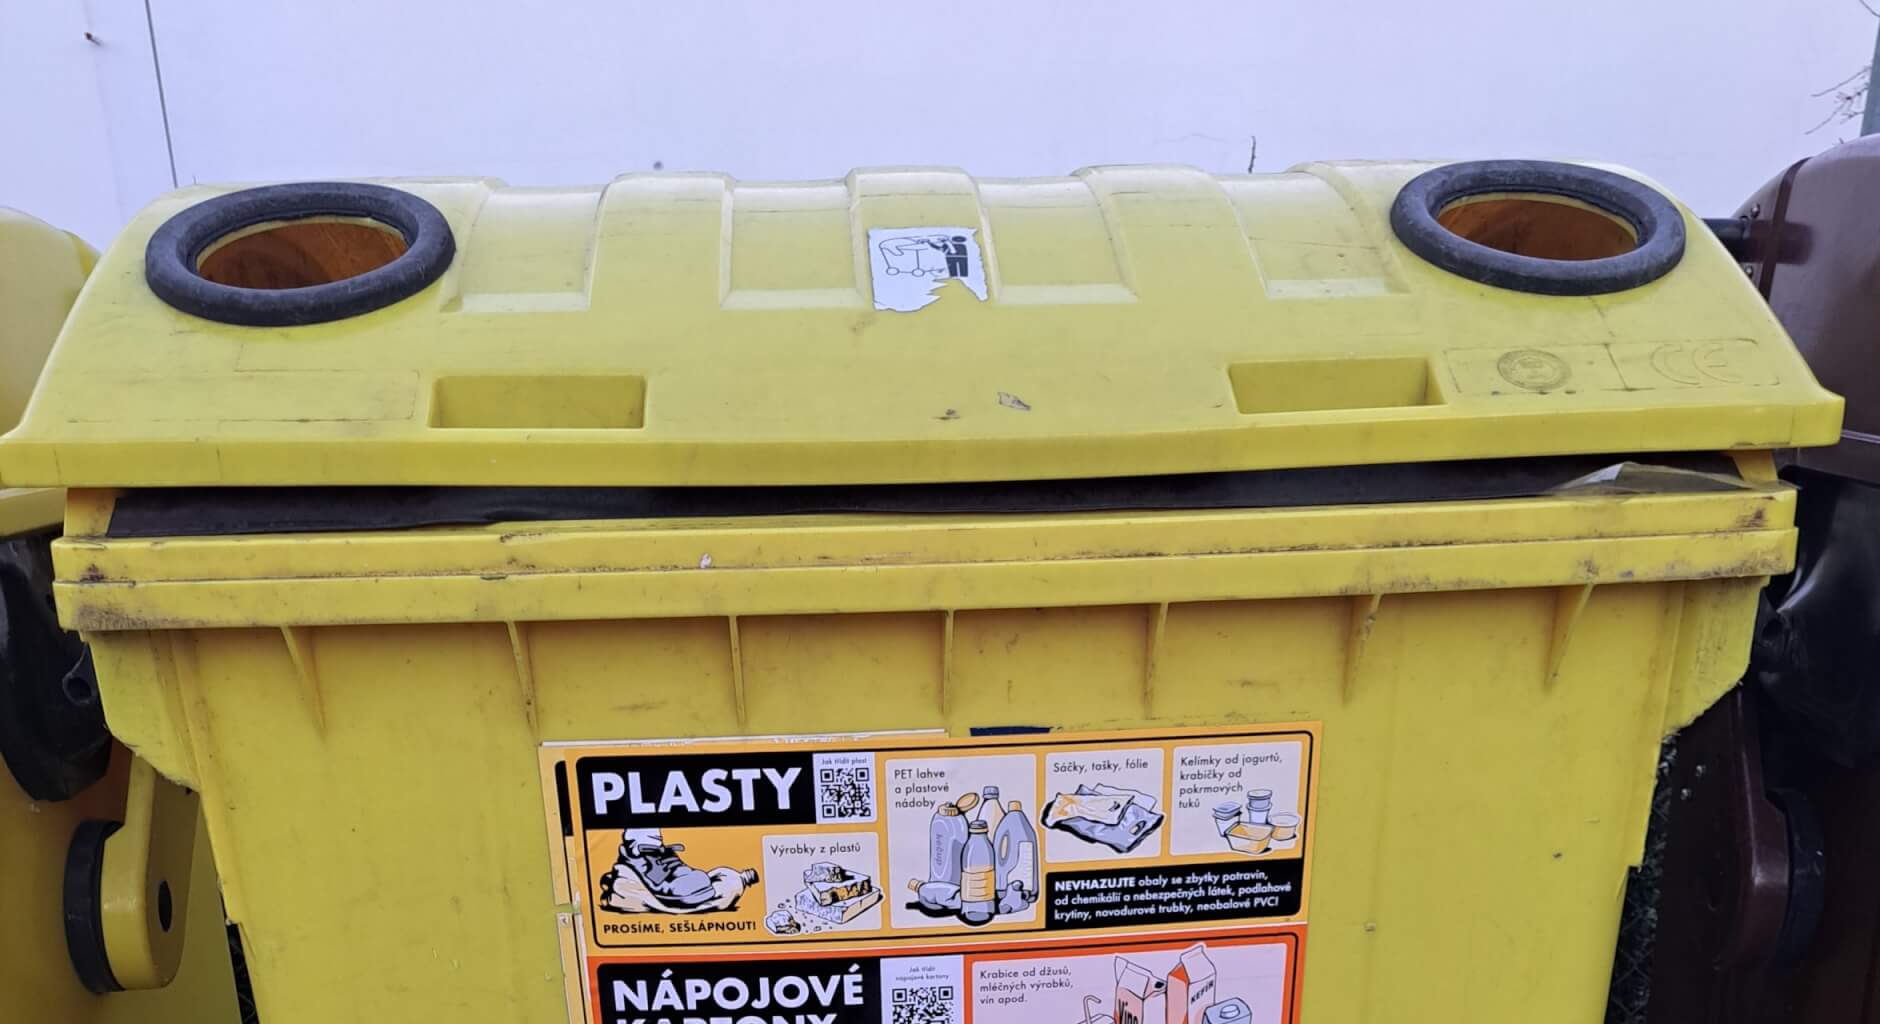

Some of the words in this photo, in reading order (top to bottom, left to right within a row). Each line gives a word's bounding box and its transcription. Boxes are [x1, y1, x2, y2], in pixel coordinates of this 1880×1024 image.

[1053, 761, 1087, 774] Sáčky,
[1092, 760, 1121, 772] tašky,
[1126, 759, 1148, 769] fólie
[1225, 754, 1239, 765] od
[1242, 753, 1282, 766] jogurtů,
[894, 770, 912, 779] PET
[917, 768, 945, 778] lahve
[1180, 769, 1225, 781] krabičky
[1228, 769, 1242, 779] od
[591, 767, 802, 815] PLASTY
[906, 784, 949, 796] plastové
[1179, 783, 1243, 797] pokrmových
[895, 798, 935, 809] nádoby
[1179, 798, 1199, 809] tuků
[770, 844, 816, 857] Výrobky
[829, 841, 861, 856] plastů
[1055, 877, 1136, 891] NEVHAZUJTE
[1139, 876, 1168, 888] obaly
[1171, 876, 1183, 885] se
[1186, 873, 1219, 886] zbytky
[1222, 870, 1268, 884] potravin,
[1055, 896, 1068, 906] od
[1123, 894, 1130, 902] a
[1133, 886, 1205, 902] nebezpečných
[1208, 884, 1234, 896] látek,
[1238, 882, 1291, 895] podlahové
[1054, 909, 1091, 922] krytiny,
[1095, 904, 1155, 917] novodurové
[1159, 902, 1193, 915] trubky,
[1197, 899, 1250, 911] neobalové
[1254, 896, 1279, 908] PVC!
[603, 920, 665, 935] PROSÍME,
[669, 918, 756, 934] SEŠLÁPNOUT!
[980, 968, 1019, 979] Krabice
[1023, 967, 1036, 977] od
[1040, 966, 1072, 978] džusů,
[612, 963, 864, 1012] NÁPOJOVÉ
[980, 979, 1026, 993] mléčných
[1030, 978, 1073, 991] výrobků,
[980, 995, 994, 1005] vín
[998, 993, 1027, 1006] apod.
